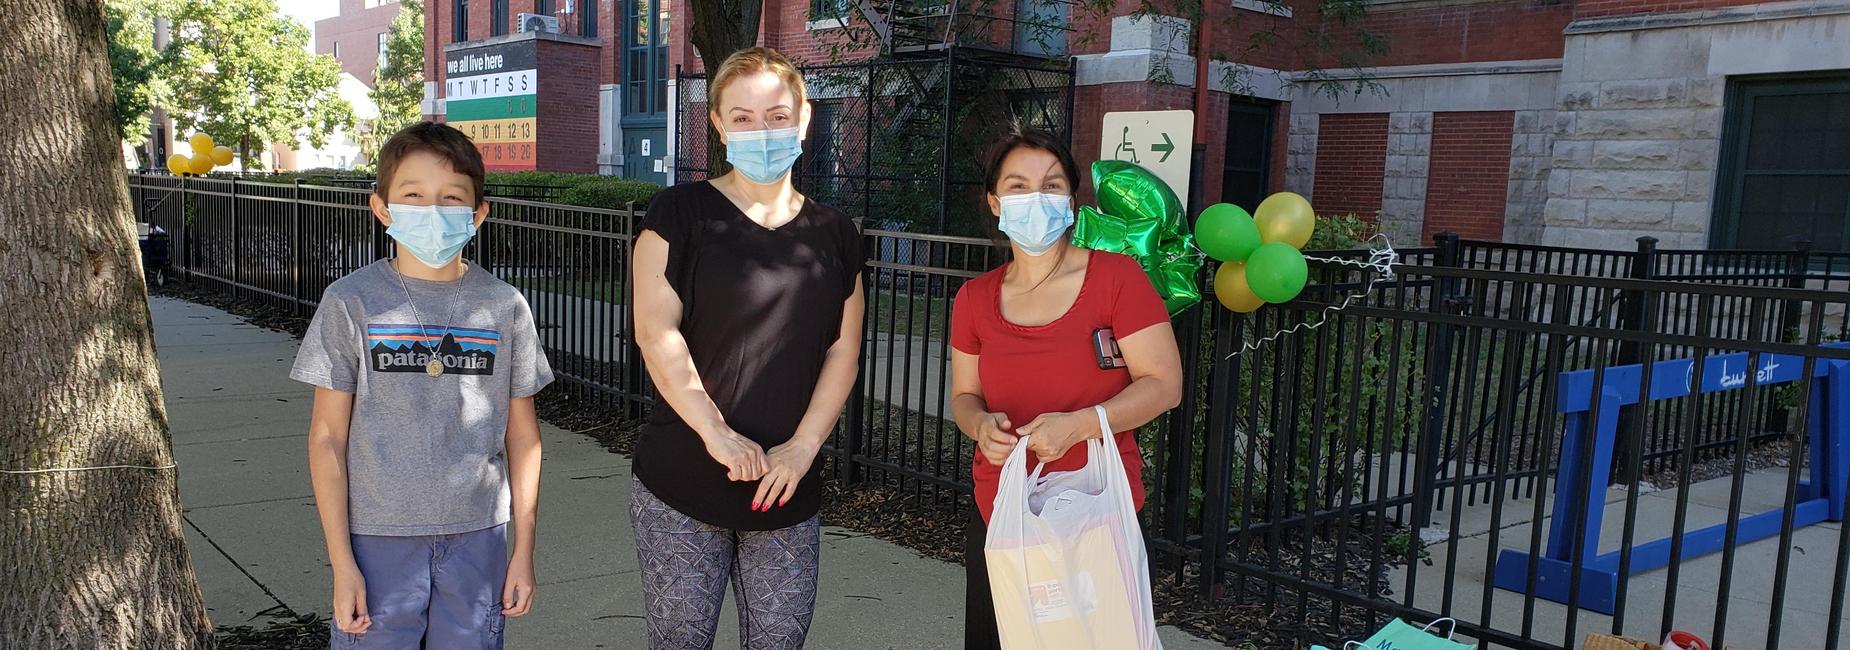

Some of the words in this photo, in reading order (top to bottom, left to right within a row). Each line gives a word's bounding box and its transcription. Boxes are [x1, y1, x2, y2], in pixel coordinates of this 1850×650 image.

[447, 60, 458, 73] we
[459, 55, 468, 72] all
[470, 54, 483, 71] live
[485, 52, 503, 70] here
[447, 82, 453, 96] M
[459, 81, 463, 96] T
[471, 80, 478, 95] W
[483, 79, 488, 94] T
[495, 78, 499, 93] F
[508, 76, 514, 92] S
[522, 74, 527, 91] S
[472, 124, 476, 138] 9
[481, 124, 489, 139] 10
[493, 124, 500, 139] 11
[508, 122, 516, 138] 12
[521, 122, 530, 138] 13
[494, 145, 501, 160] 18
[508, 144, 516, 160] 19
[521, 144, 530, 160] 20
